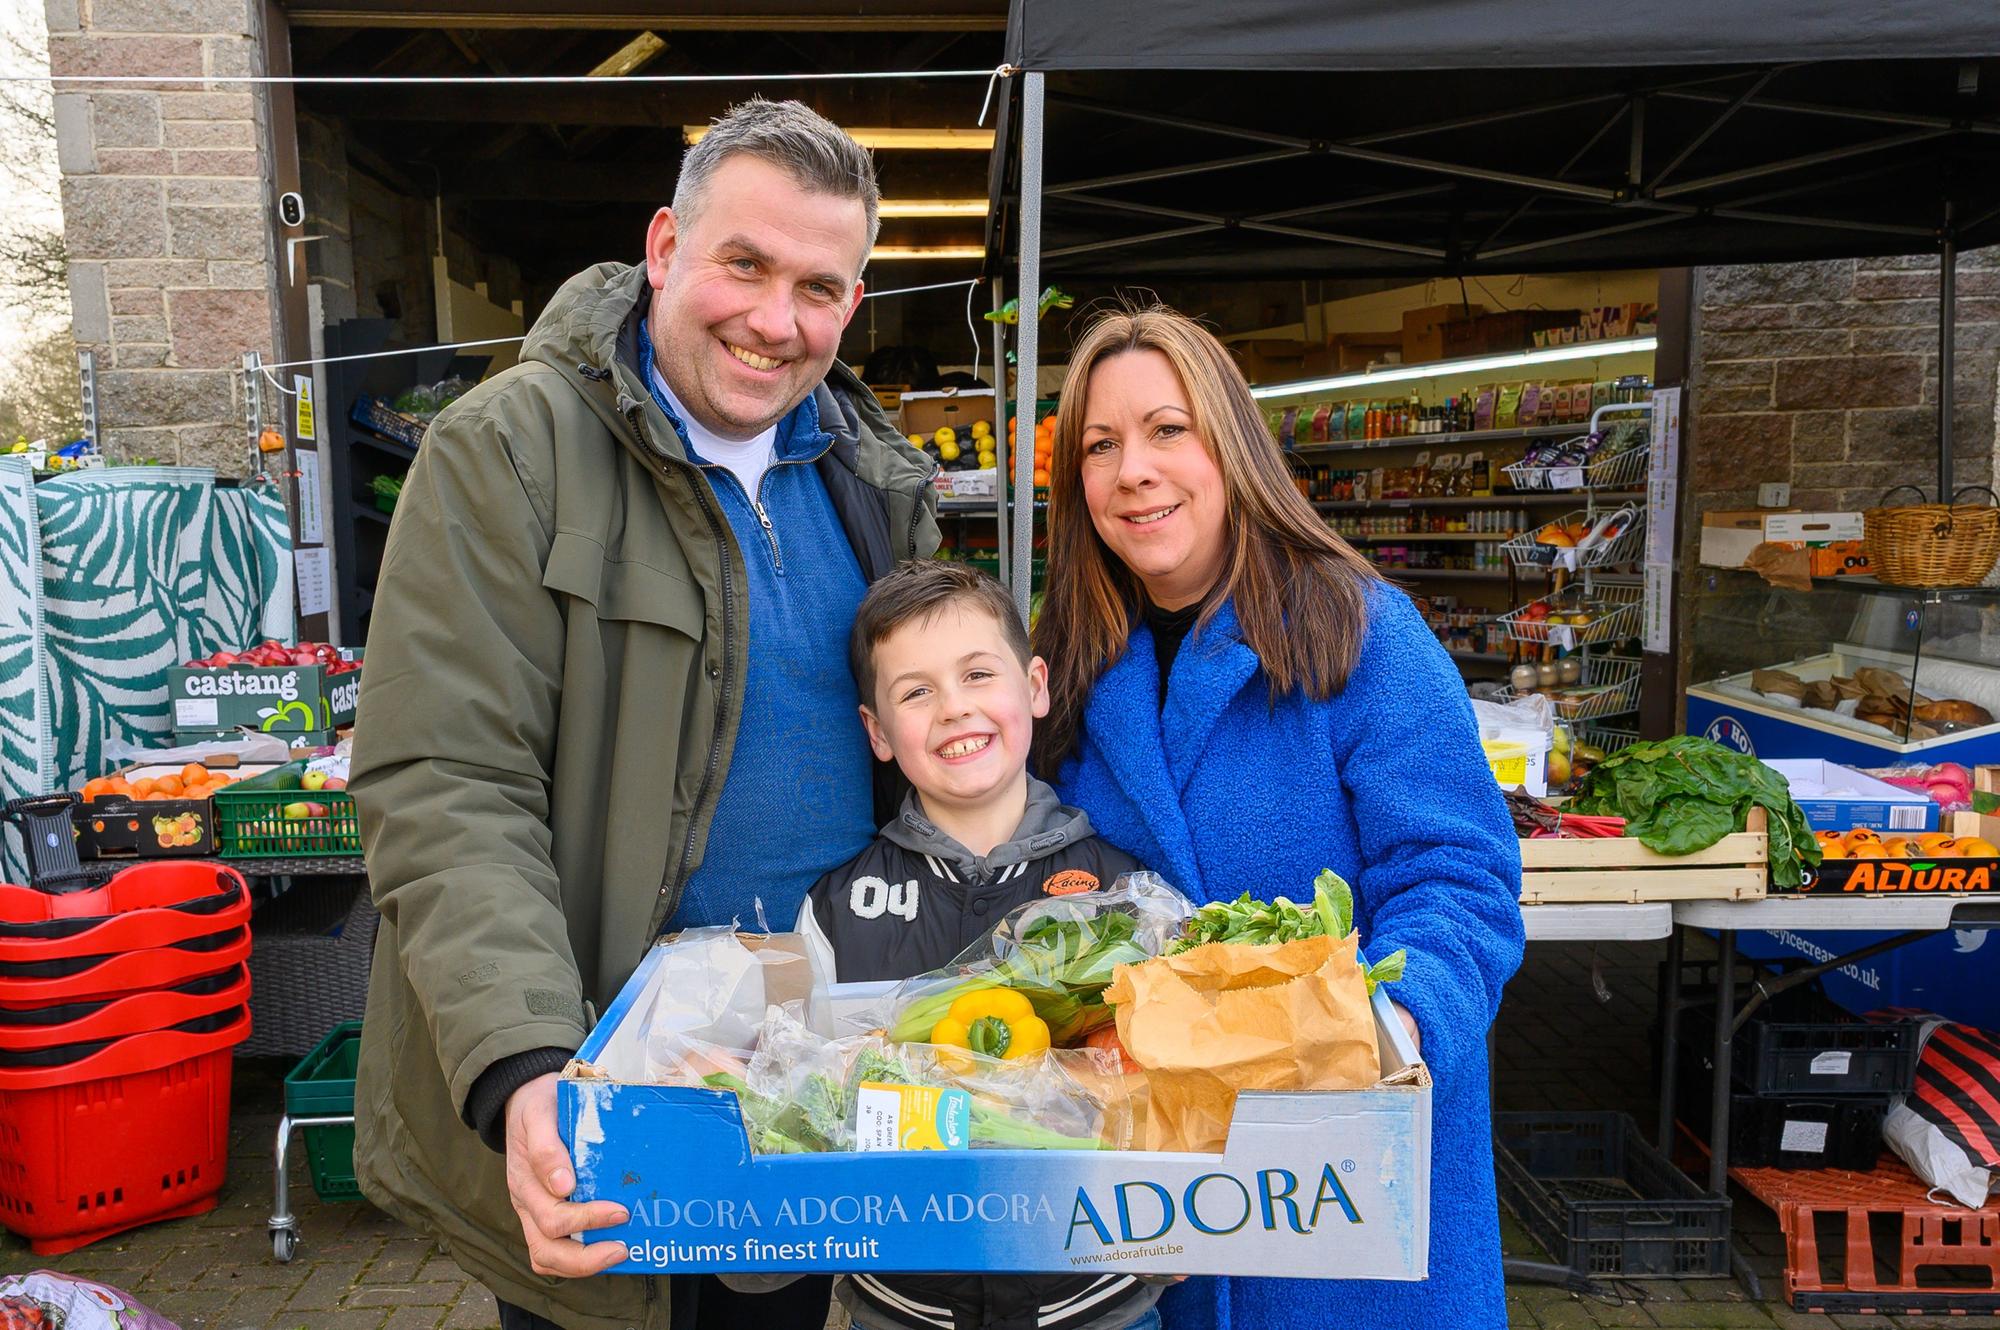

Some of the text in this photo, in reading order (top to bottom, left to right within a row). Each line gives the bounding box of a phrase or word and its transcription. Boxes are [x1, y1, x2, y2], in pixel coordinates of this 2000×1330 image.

[185, 671, 299, 701] castang
[331, 676, 361, 714] cast
[1046, 872, 1100, 893] Racing
[1843, 863, 1990, 891] ALTURA
[849, 875, 919, 922] 04
[628, 1192, 1056, 1230] ADORA ADORA ADORA
[615, 1235, 879, 1268] elgium's finest fruit
[1070, 1243, 1184, 1266] www.adorafruit.be
